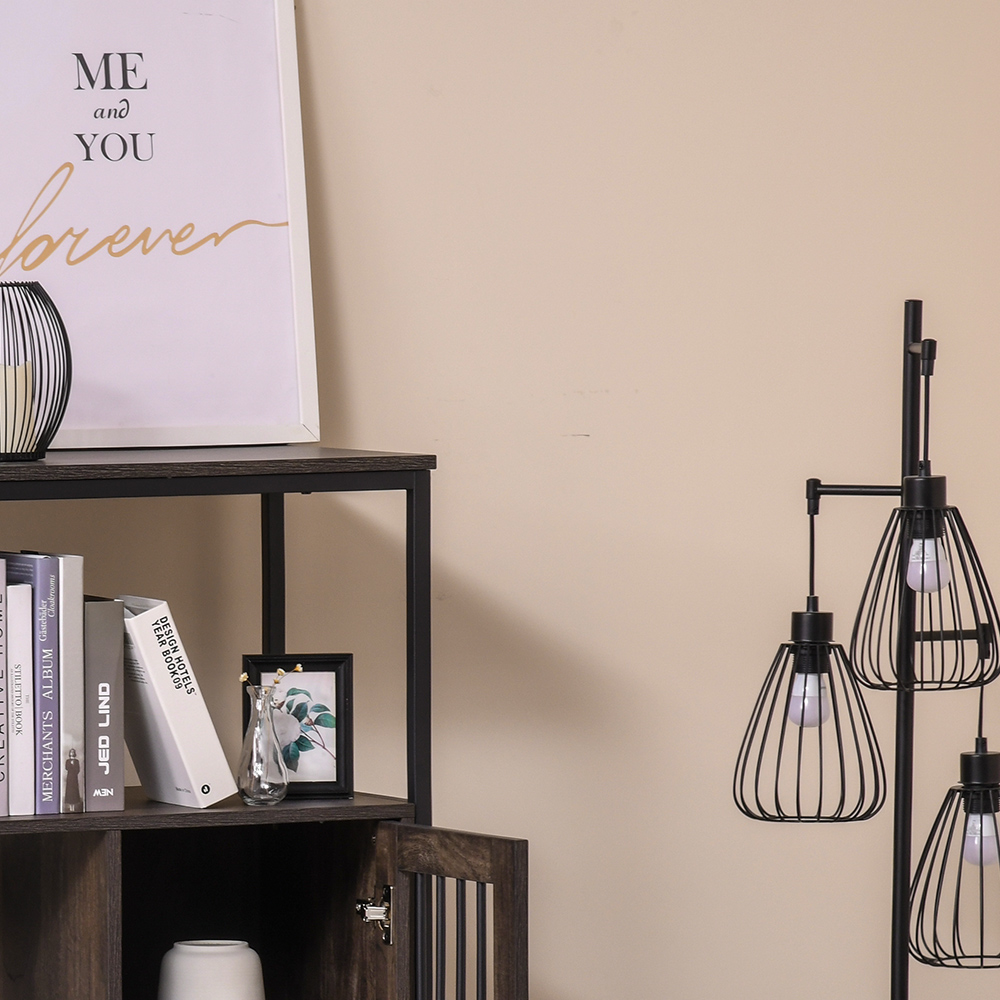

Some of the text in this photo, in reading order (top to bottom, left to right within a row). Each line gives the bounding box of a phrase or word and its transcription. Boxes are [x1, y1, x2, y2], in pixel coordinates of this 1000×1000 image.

[71, 52, 148, 90] ME
[93, 98, 130, 119] and
[73, 132, 155, 162] YOU
[47, 574, 56, 618] Cloakrooms
[151, 619, 183, 690] YEAR BOOK09
[160, 615, 195, 695] DESIGN HOTELS
[41, 648, 54, 802] MERCHANTS ALBUM
[98, 682, 110, 775] JED LIND
